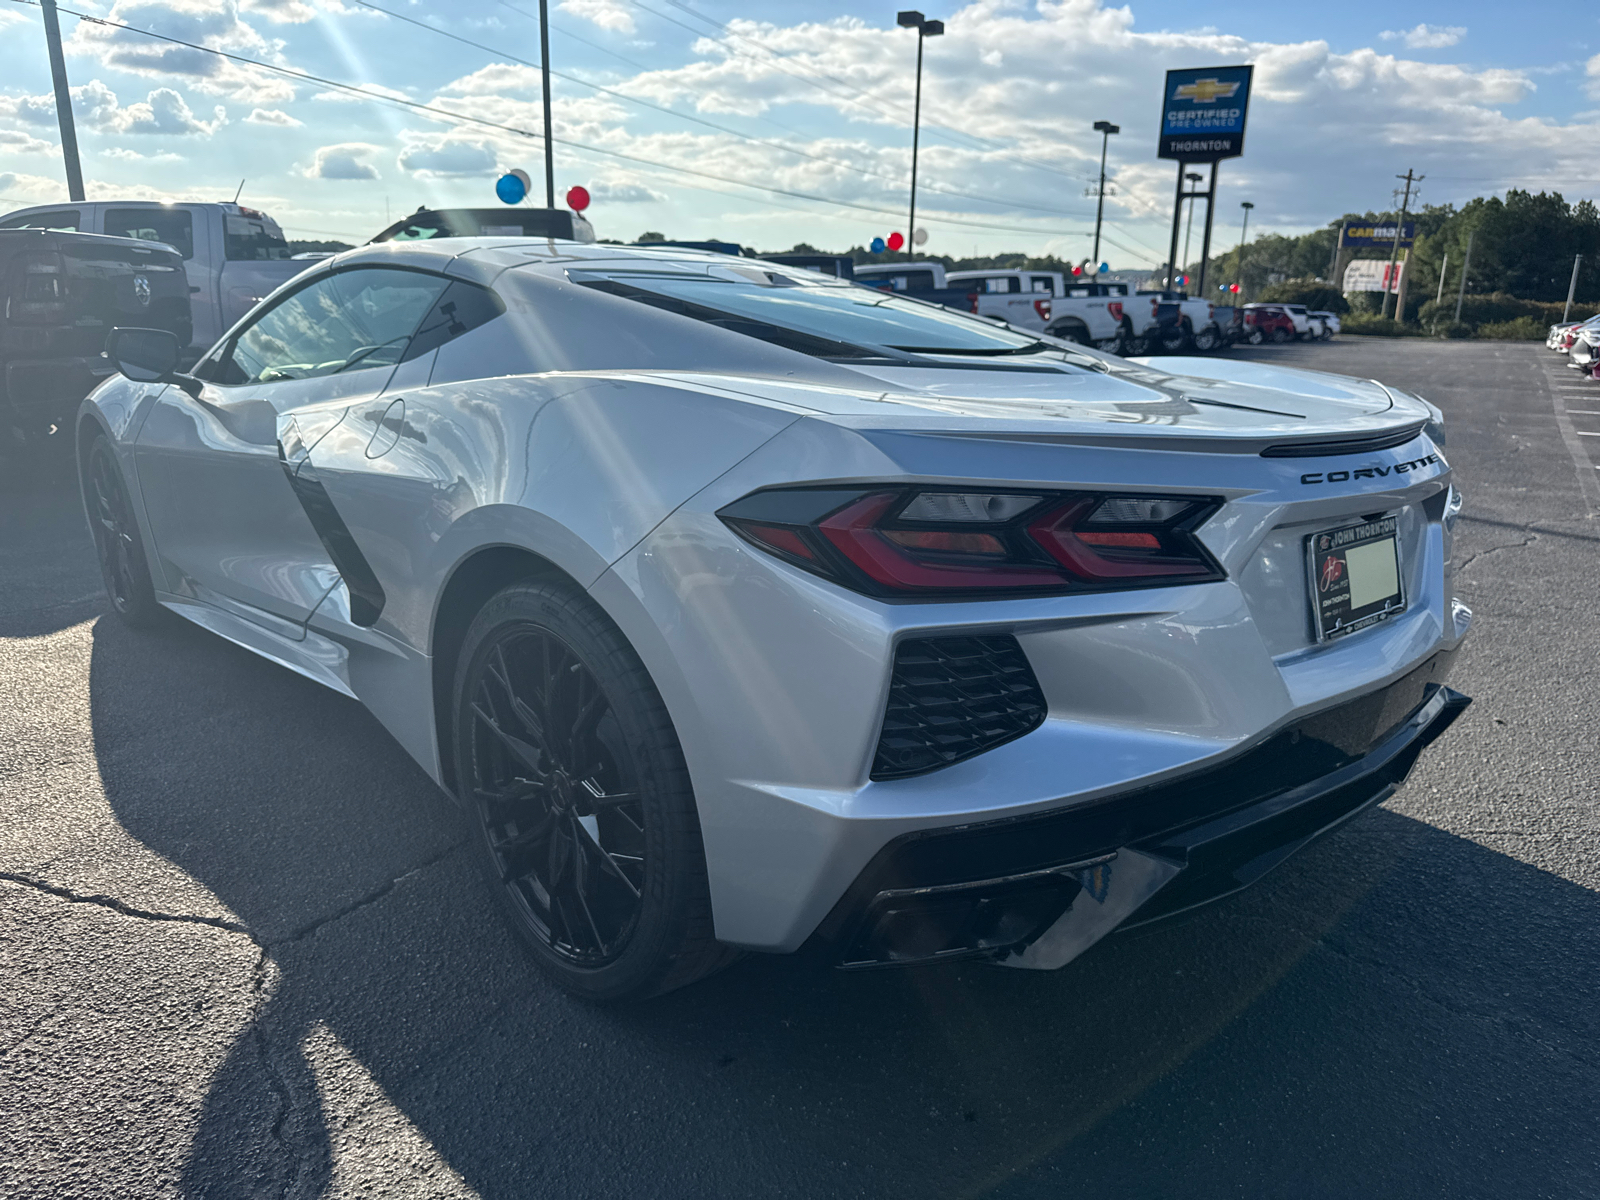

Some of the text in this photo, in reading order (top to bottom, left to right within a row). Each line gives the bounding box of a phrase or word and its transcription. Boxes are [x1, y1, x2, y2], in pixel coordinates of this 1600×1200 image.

[1168, 109, 1240, 121] CERTIFIED
[1170, 140, 1231, 152] THORNTON
[1300, 454, 1440, 485] CORVETTE
[1331, 530, 1355, 547] JOHN
[1355, 519, 1396, 541] THORNTON
[1354, 614, 1379, 631] CHEVROLET
